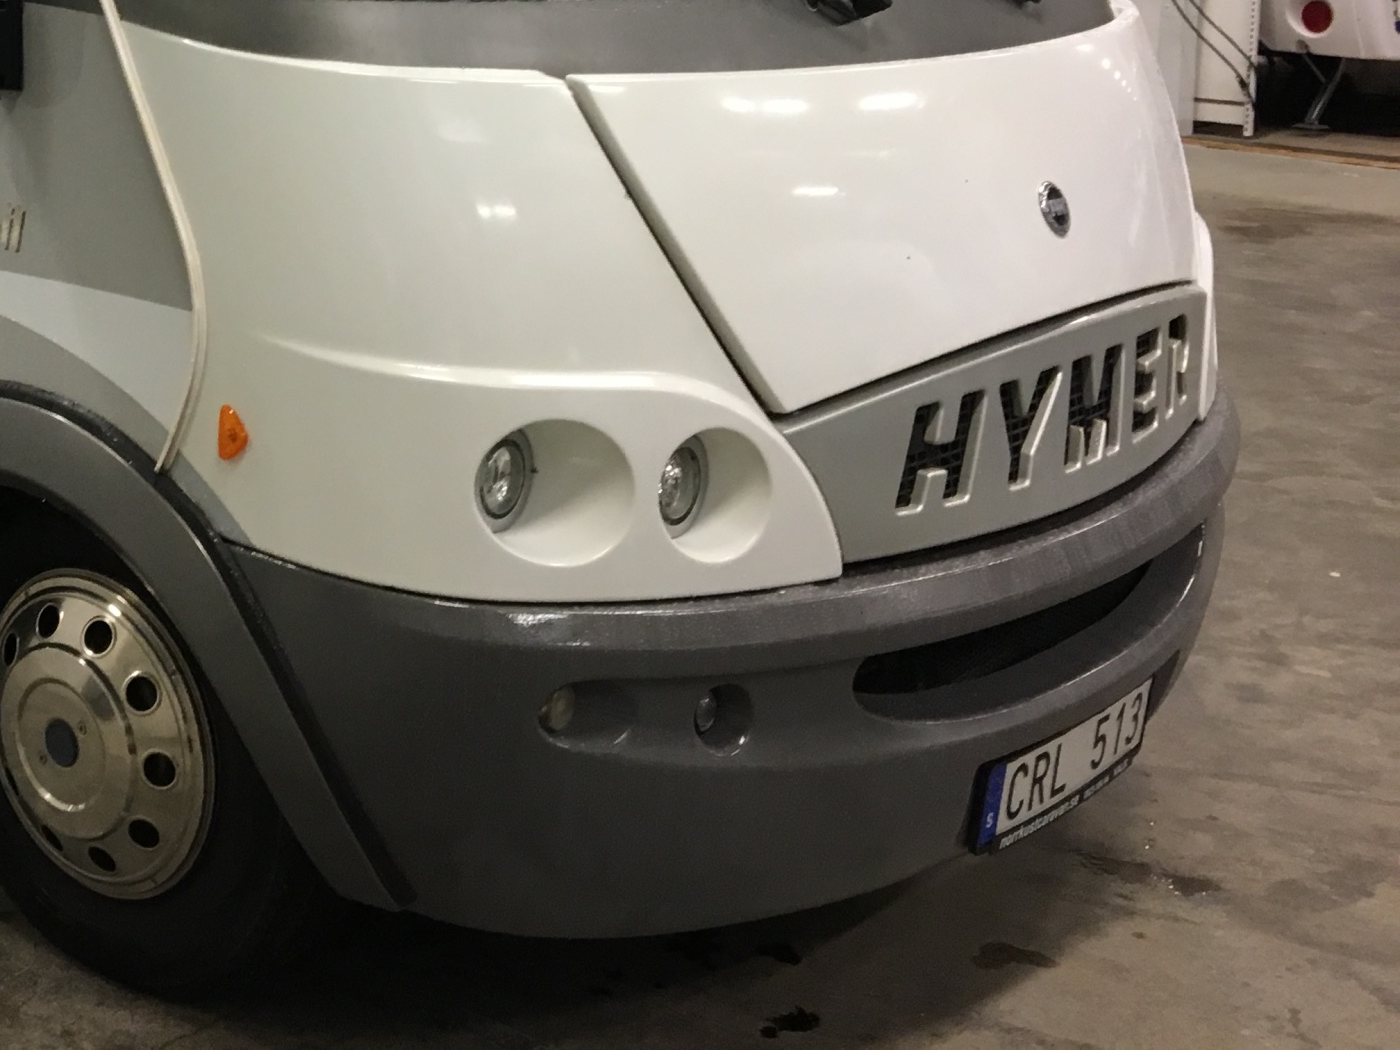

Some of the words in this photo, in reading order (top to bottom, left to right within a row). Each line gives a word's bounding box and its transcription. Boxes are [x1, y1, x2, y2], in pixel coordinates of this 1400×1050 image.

[895, 313, 1190, 516] HYMER
[985, 811, 994, 829] S
[1006, 742, 1067, 821] CRL
[1090, 692, 1144, 770] 513
